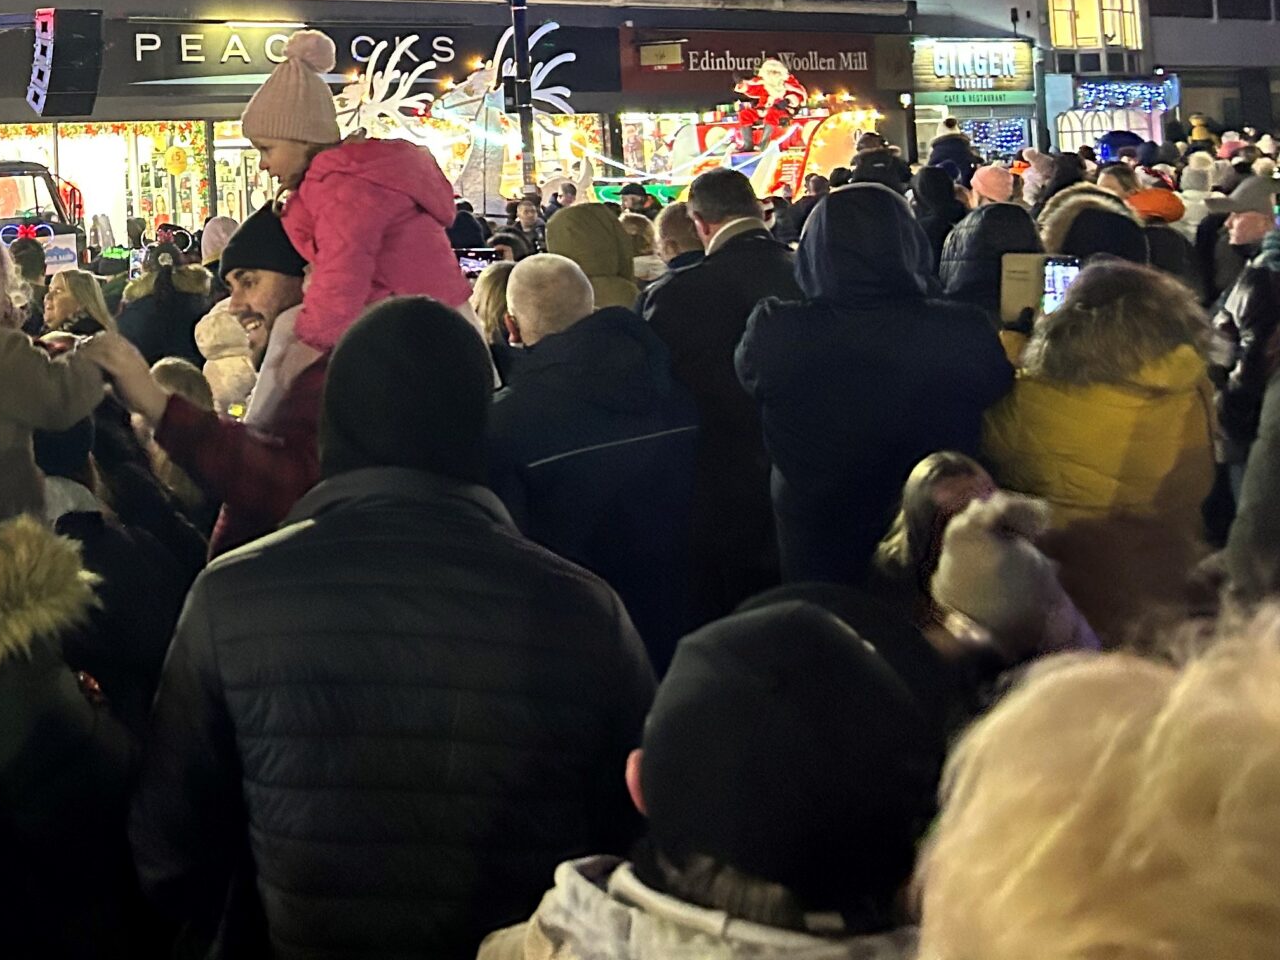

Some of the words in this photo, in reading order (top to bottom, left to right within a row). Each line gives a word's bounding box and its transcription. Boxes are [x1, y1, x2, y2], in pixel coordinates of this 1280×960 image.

[135, 33, 455, 63] PEACCKS
[777, 50, 836, 71] Woollen
[839, 51, 868, 71] Mill
[933, 44, 1016, 76] GINGER
[955, 78, 993, 89] KITCHEN
[968, 93, 1007, 103] RESTAURANT
